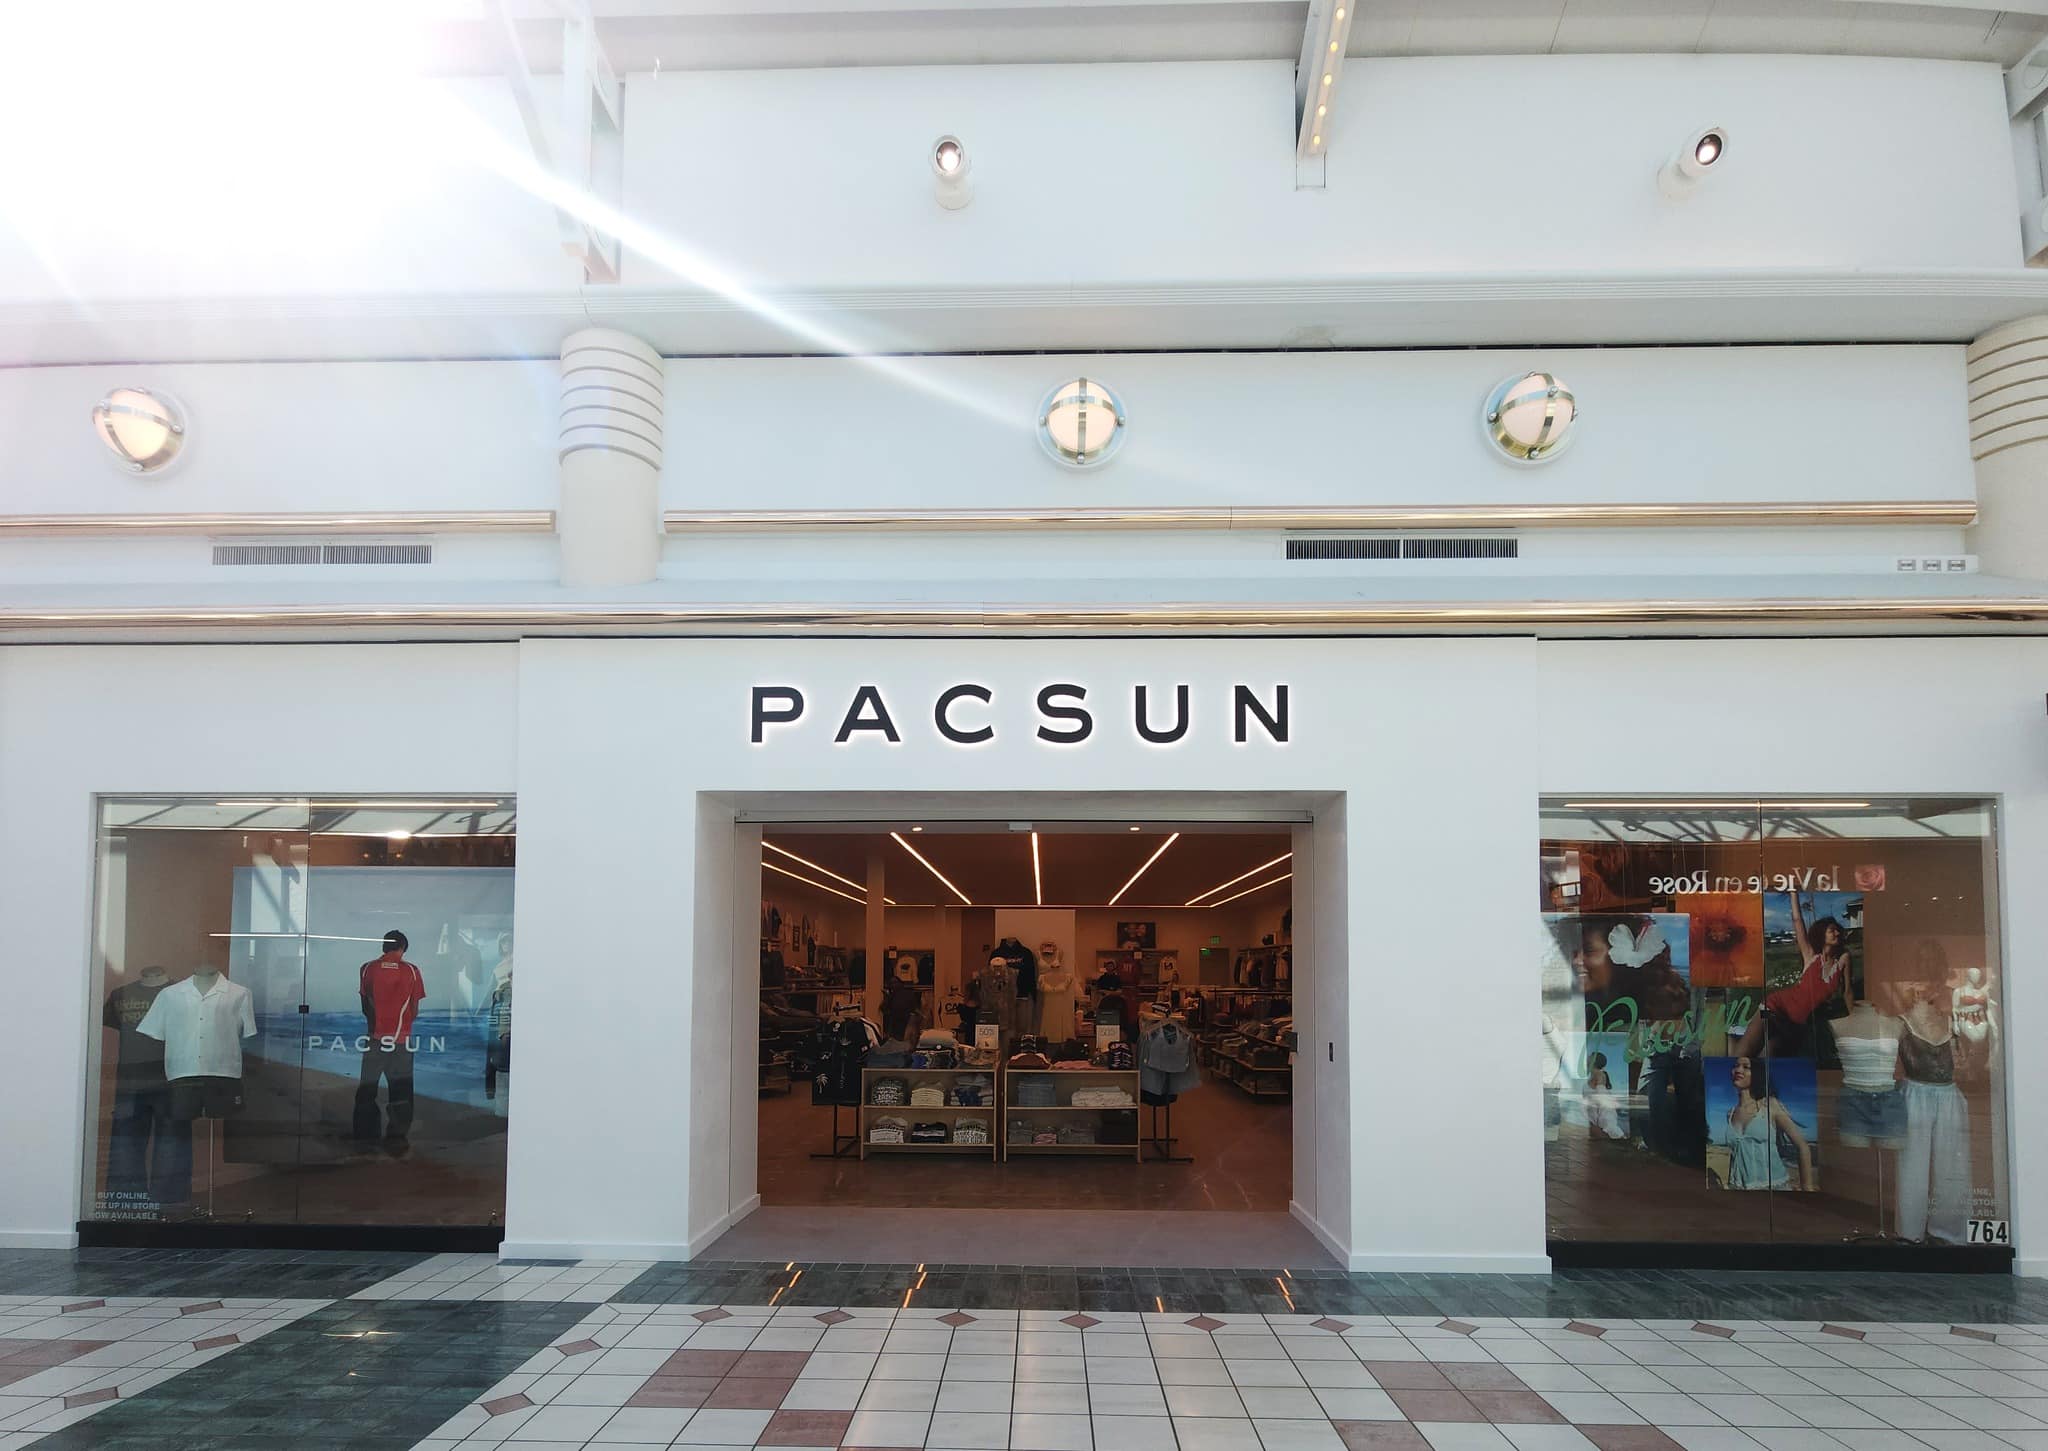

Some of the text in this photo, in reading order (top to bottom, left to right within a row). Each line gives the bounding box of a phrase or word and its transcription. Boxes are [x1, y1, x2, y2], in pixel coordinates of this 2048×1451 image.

[751, 684, 1288, 743] PACSUN
[308, 1035, 446, 1052] PACSUN
[1969, 1221, 2007, 1243] 764
